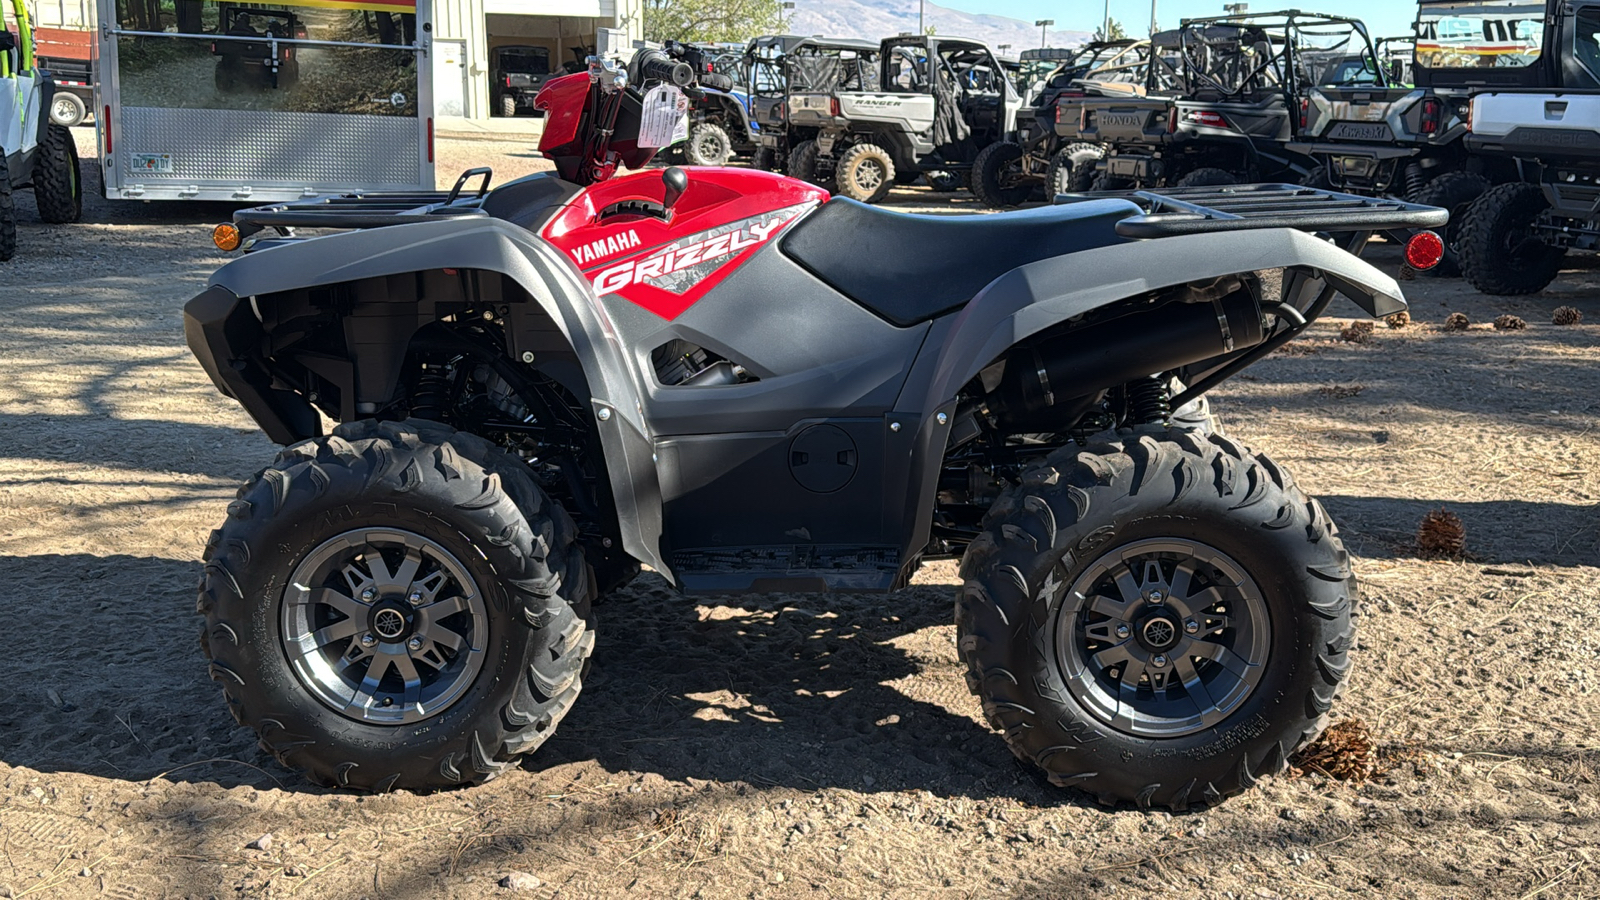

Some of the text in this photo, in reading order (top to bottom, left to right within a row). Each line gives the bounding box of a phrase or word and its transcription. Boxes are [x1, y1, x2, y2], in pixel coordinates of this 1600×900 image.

[1101, 115, 1142, 126] HONDA
[1338, 124, 1386, 139] Kawasaki
[571, 229, 642, 264] YAMAHA
[592, 216, 781, 298] GRIZZLY
